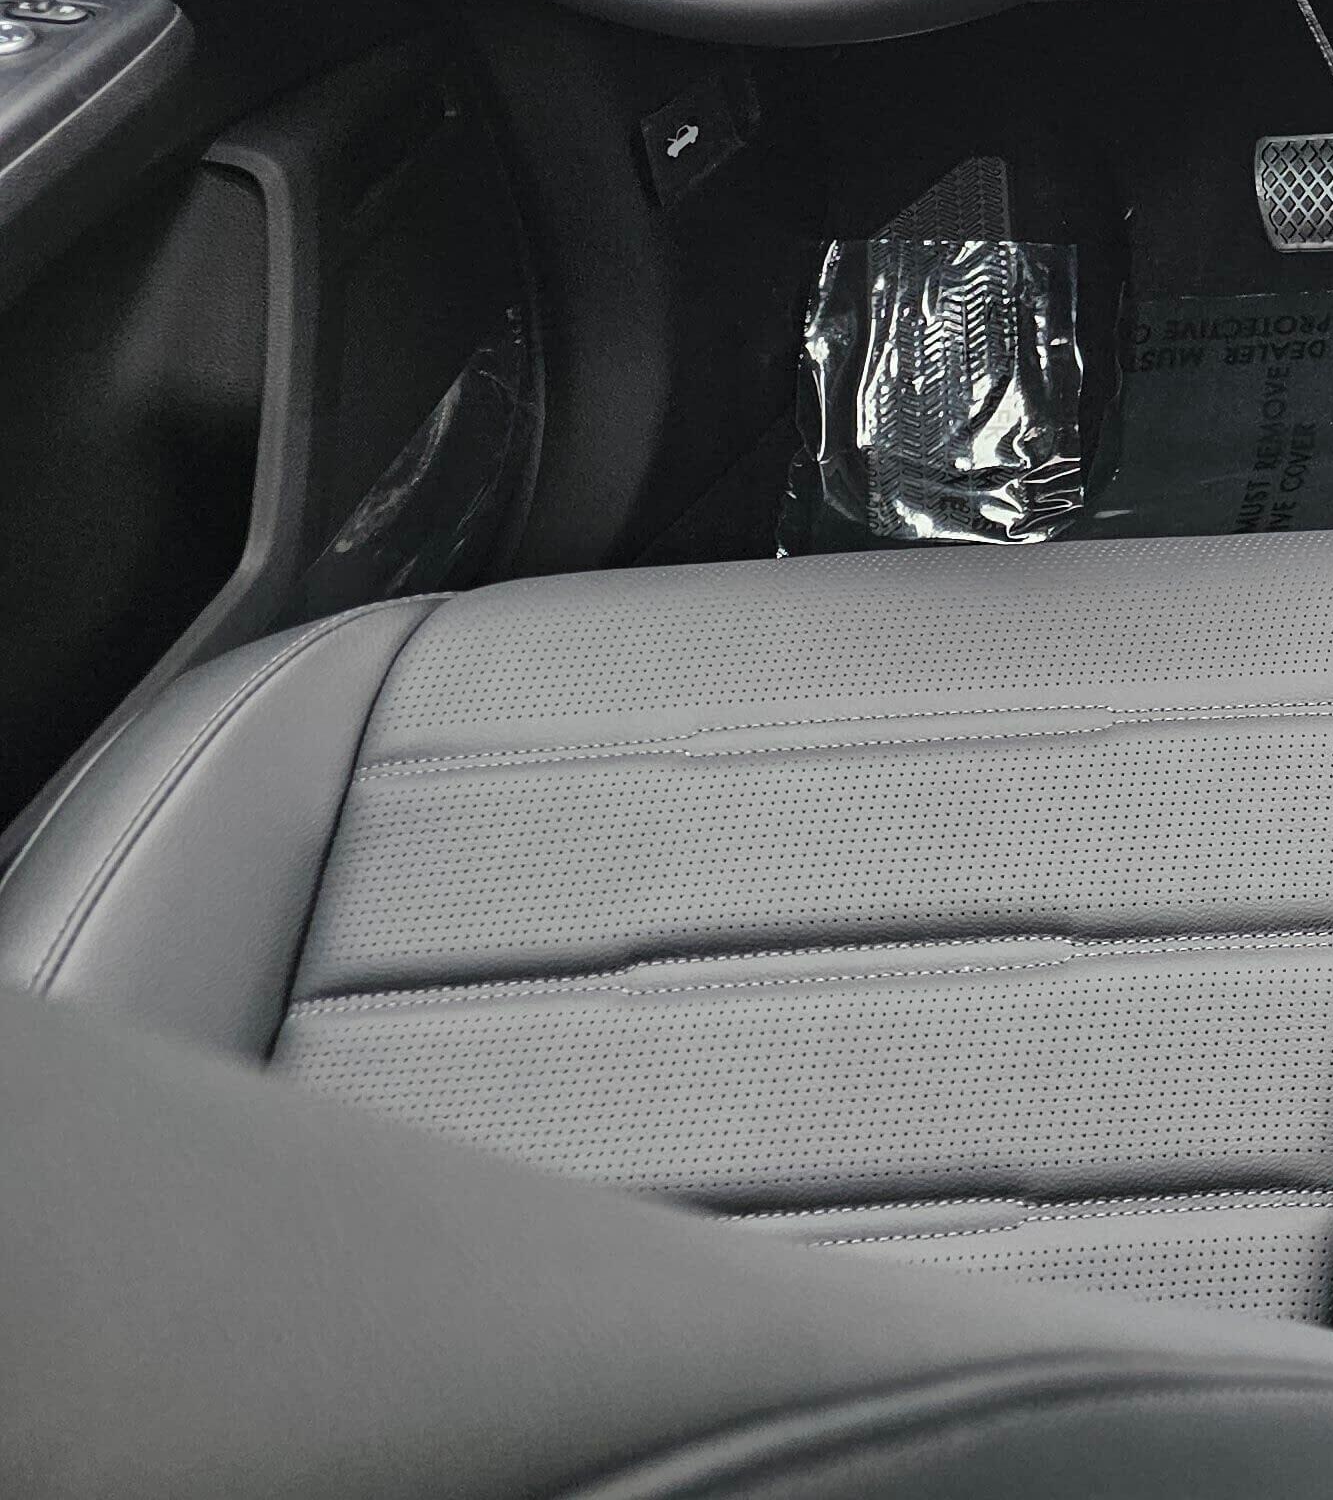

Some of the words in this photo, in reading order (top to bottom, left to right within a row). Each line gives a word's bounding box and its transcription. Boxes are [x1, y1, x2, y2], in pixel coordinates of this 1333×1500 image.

[1164, 315, 1331, 341] PROTECTIVE
[1223, 340, 1327, 366] DEALER
[1253, 366, 1288, 470] REMOVE
[1279, 423, 1315, 492] COVER
